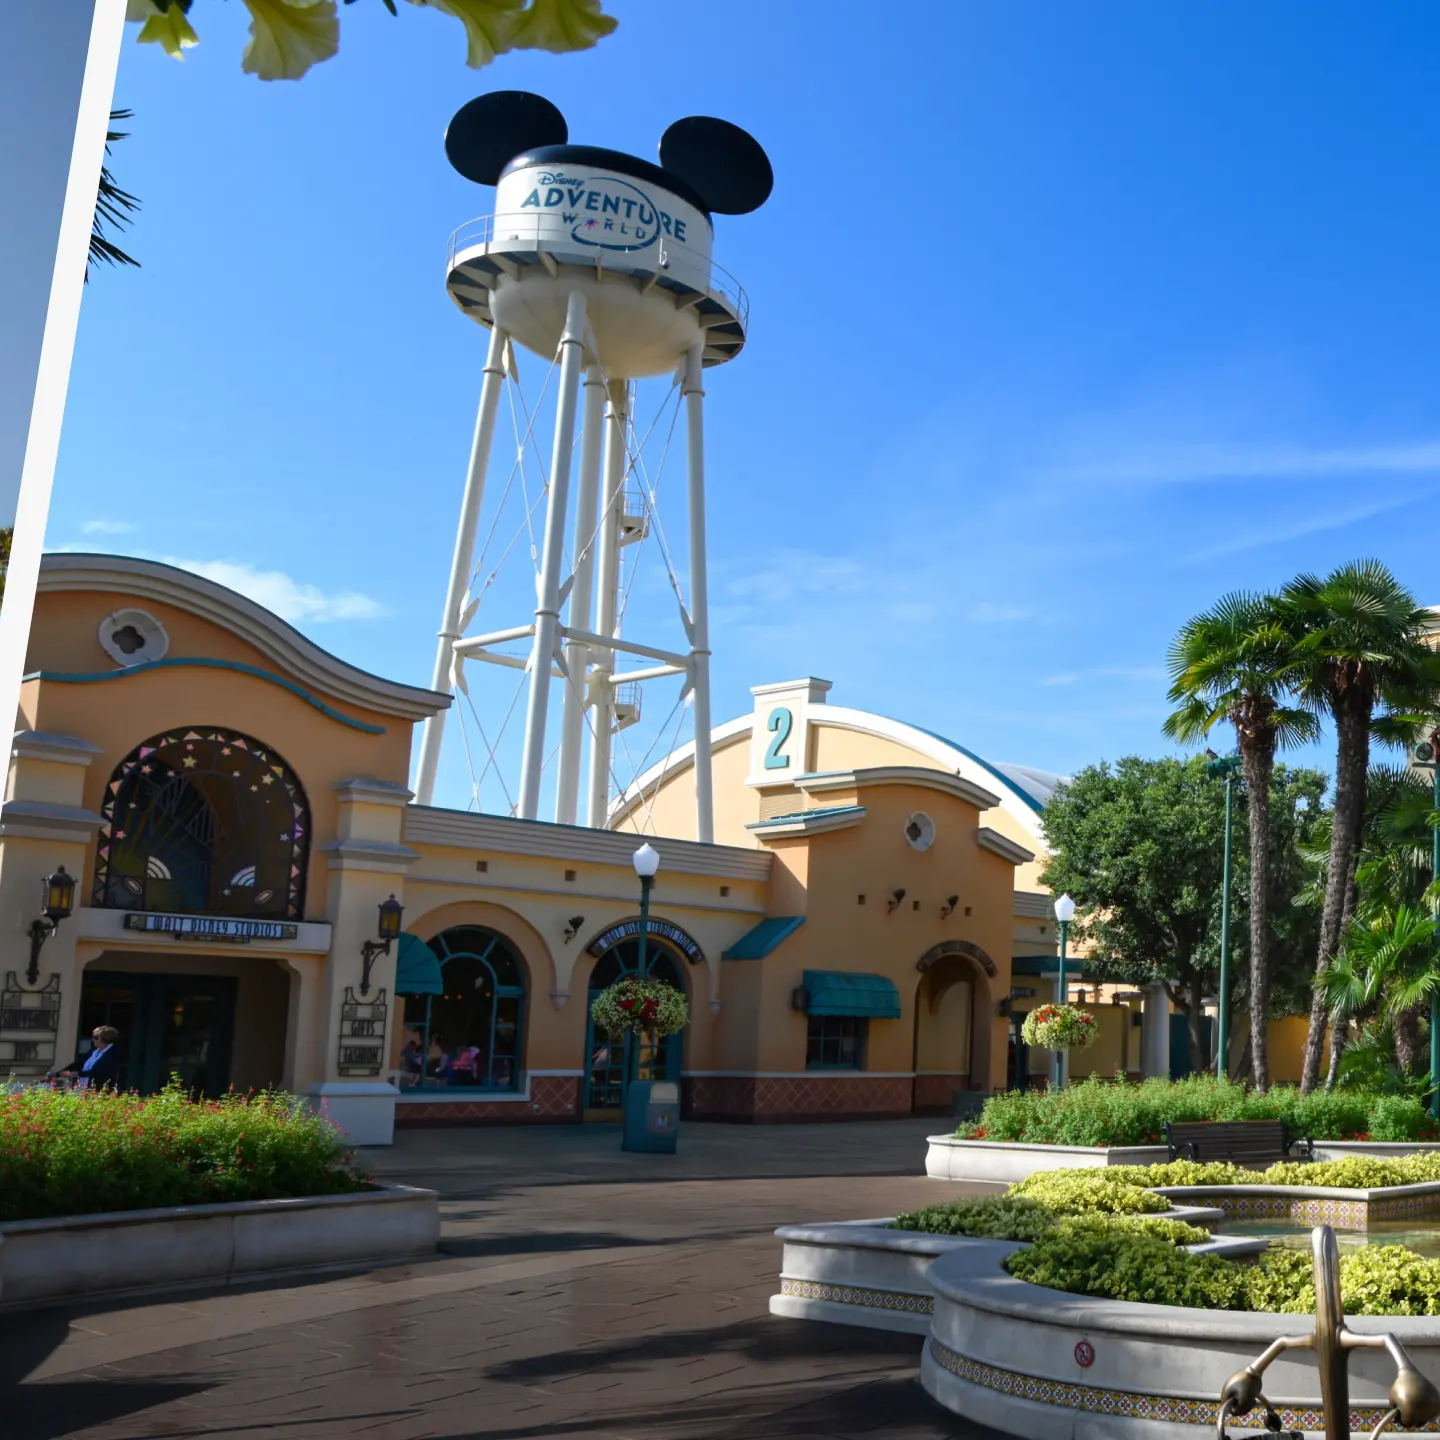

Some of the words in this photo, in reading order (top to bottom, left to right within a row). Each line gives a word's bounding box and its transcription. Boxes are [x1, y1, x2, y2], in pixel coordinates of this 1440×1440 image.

[520, 188, 687, 243] ADVENTURE
[763, 706, 794, 771] 2
[153, 914, 184, 932] WALT
[191, 917, 228, 935] DISNEY
[235, 921, 278, 938] STUDIOS
[352, 1019, 375, 1036] GIFTS
